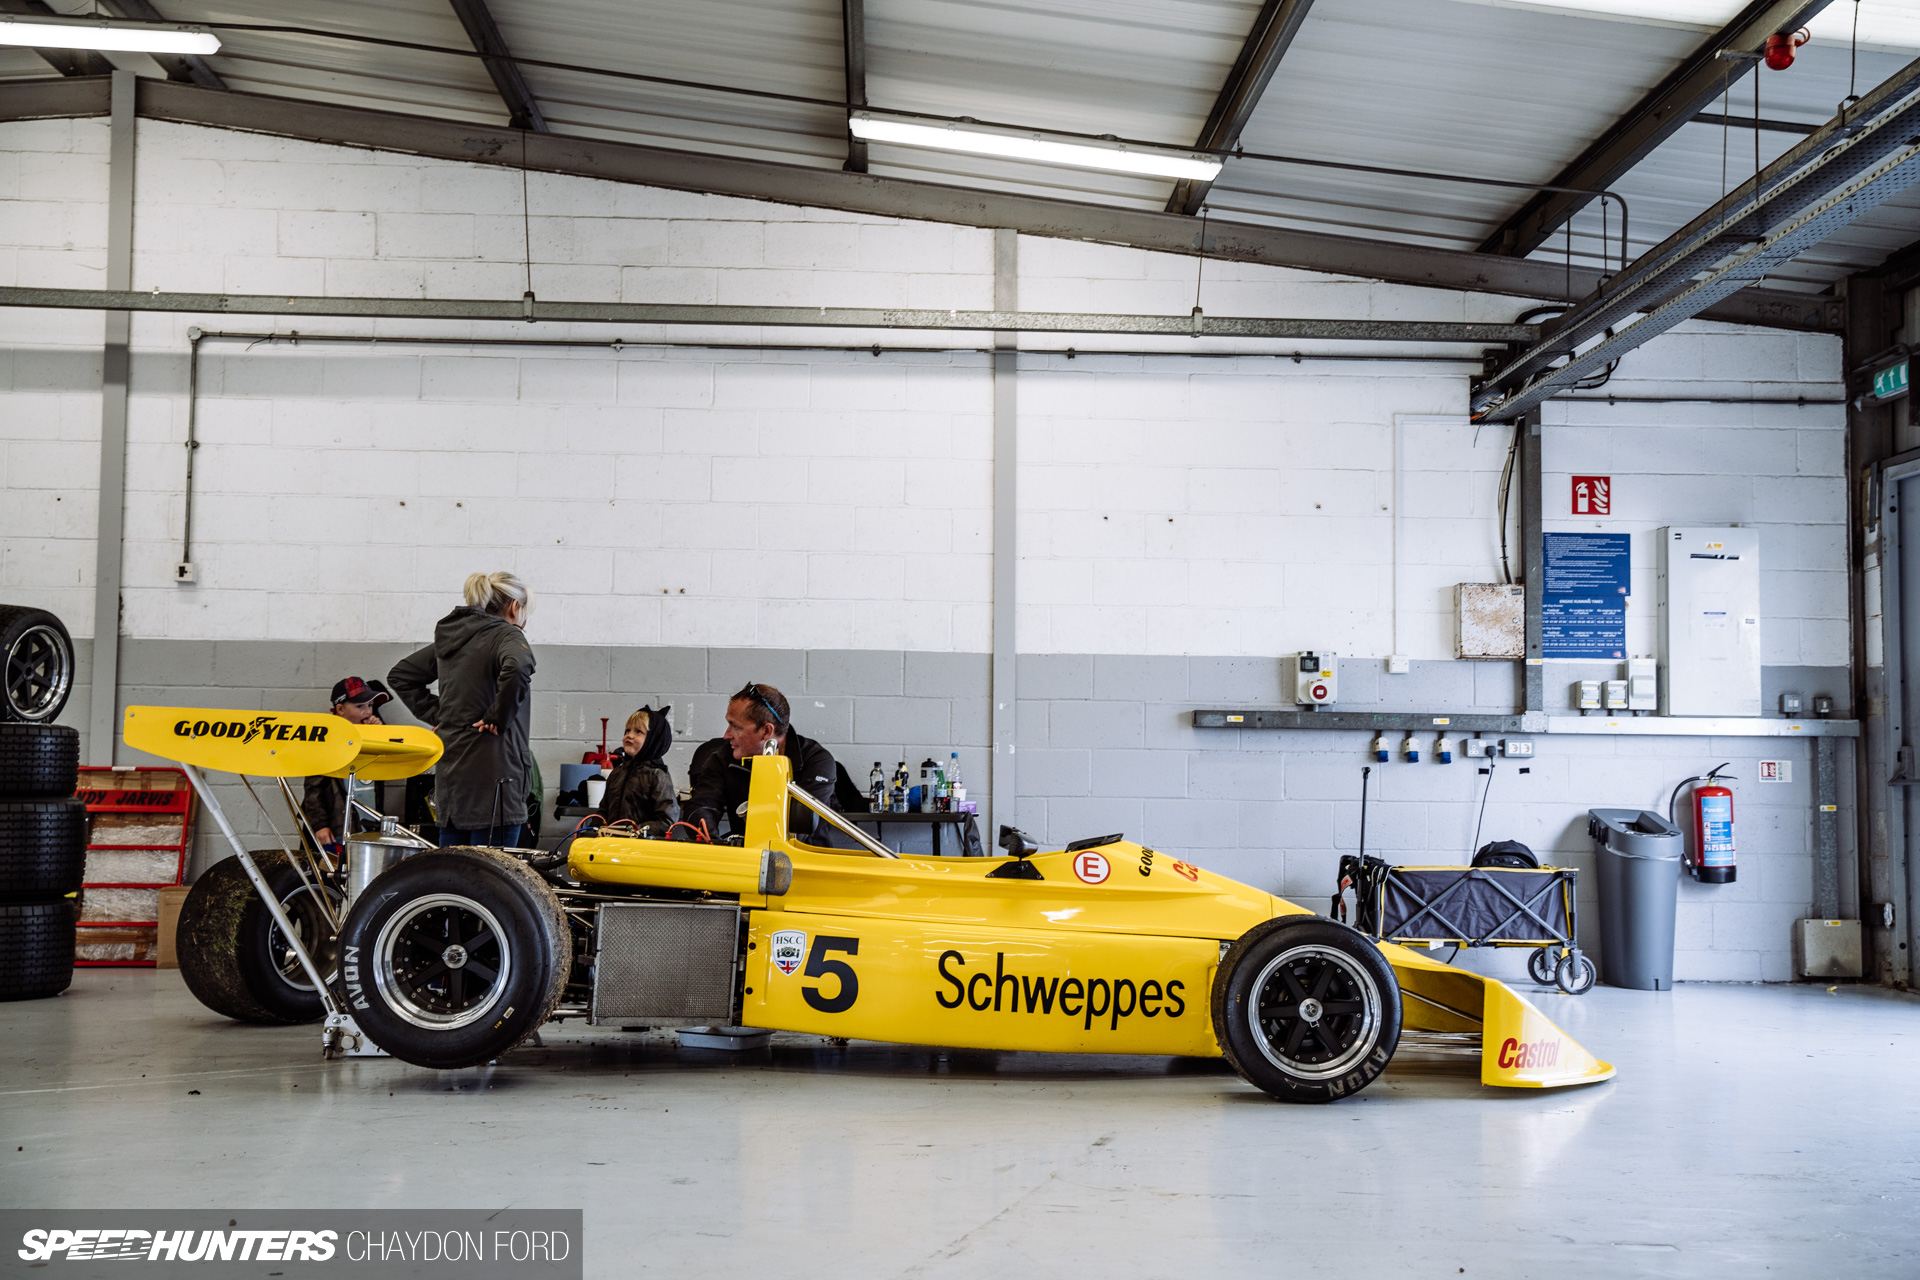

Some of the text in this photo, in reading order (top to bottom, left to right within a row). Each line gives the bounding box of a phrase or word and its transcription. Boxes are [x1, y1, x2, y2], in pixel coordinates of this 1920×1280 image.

[116, 791, 175, 806] JARVIS
[1083, 856, 1101, 878] E
[776, 936, 803, 945] HSCC
[344, 945, 370, 1010] AVON
[801, 934, 860, 1014] 5
[935, 950, 1186, 1031] Schweppes
[1327, 1045, 1389, 1097] AVON
[1498, 1037, 1561, 1069] Castrol
